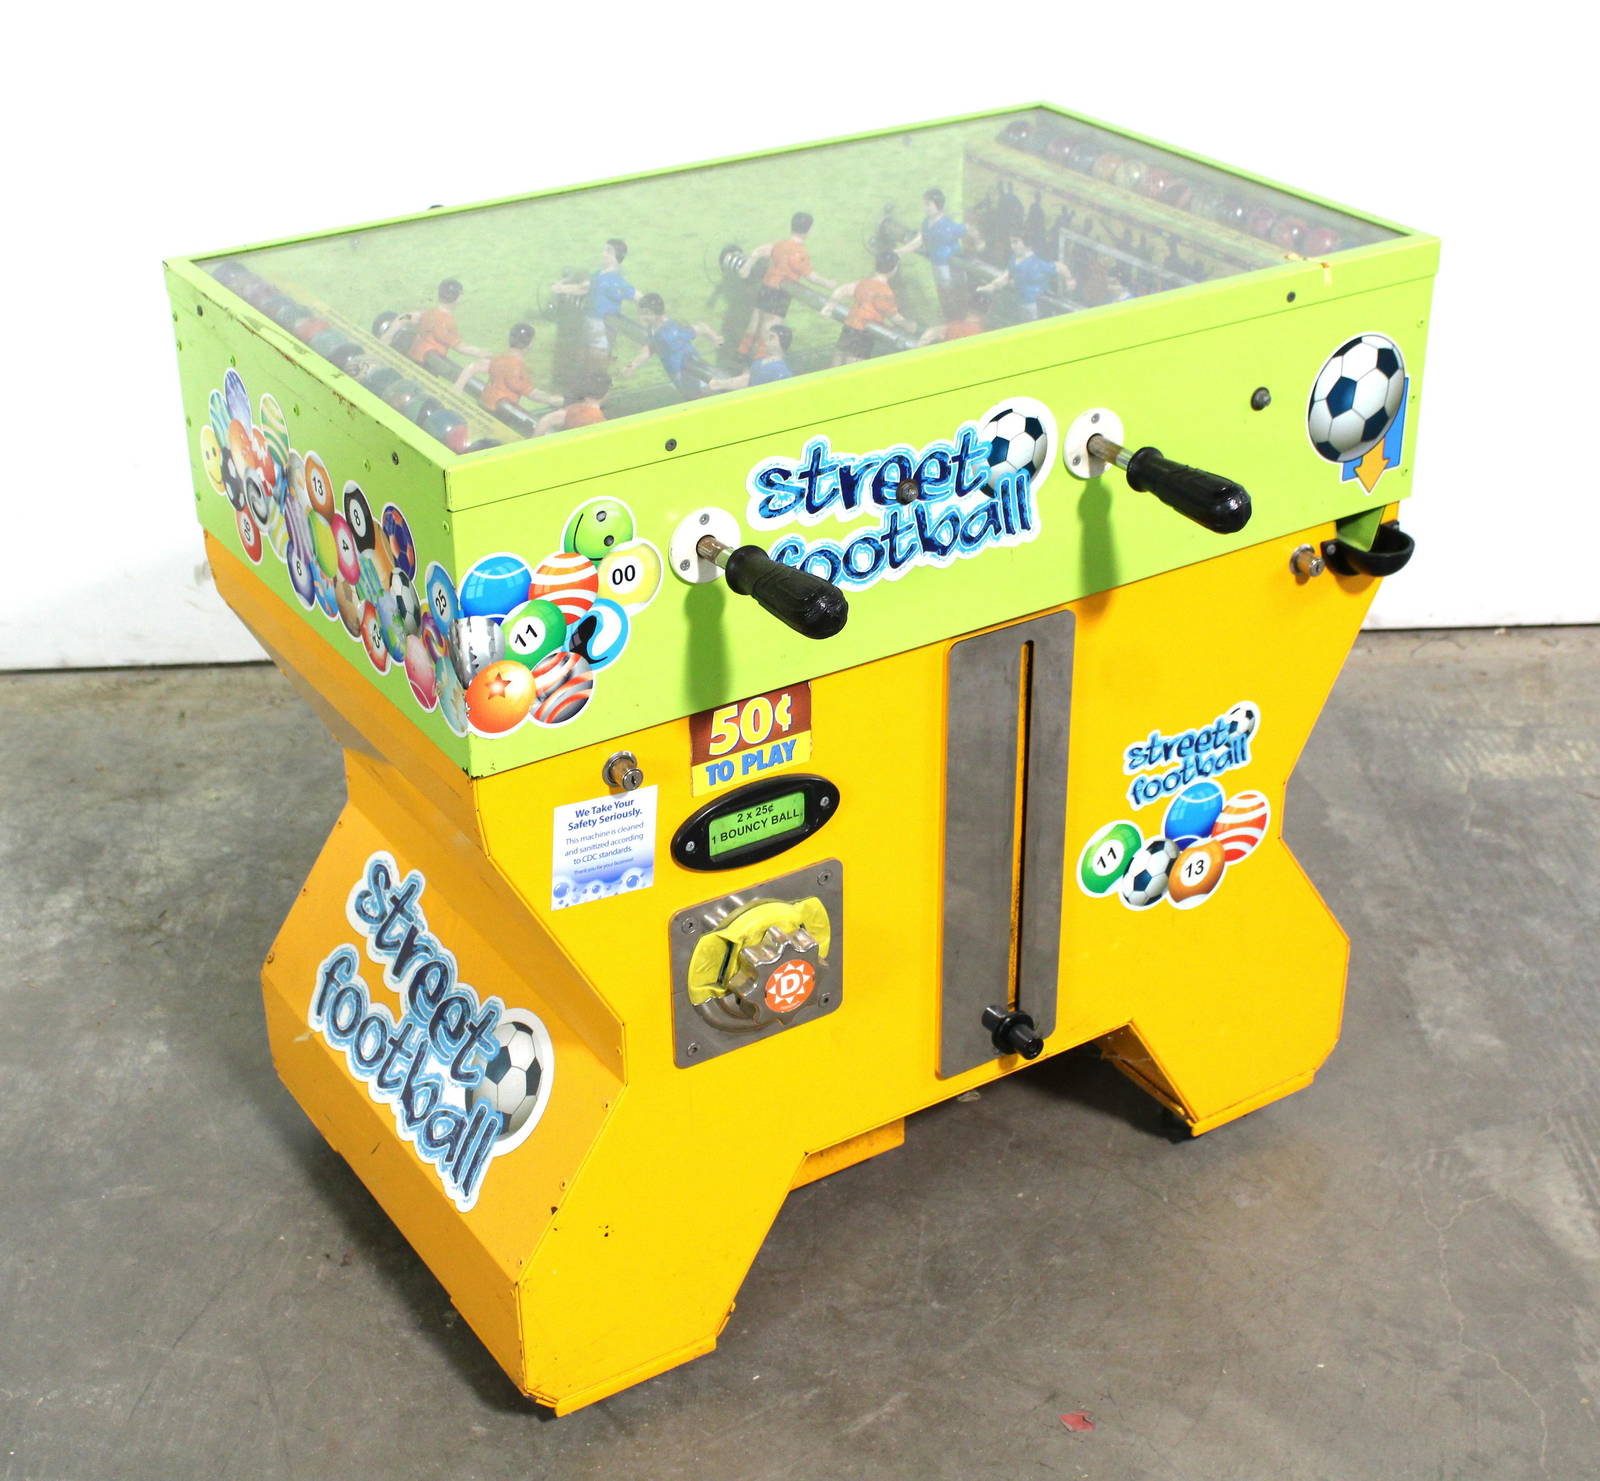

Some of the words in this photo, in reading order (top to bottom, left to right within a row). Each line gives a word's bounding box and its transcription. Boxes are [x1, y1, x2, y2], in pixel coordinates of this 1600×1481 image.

[755, 427, 992, 520] street
[313, 476, 324, 496] 13
[353, 509, 361, 526] 8
[342, 539, 349, 552] 4
[611, 564, 636, 586] 00
[435, 589, 447, 617] 25
[514, 624, 538, 648] 11
[708, 693, 792, 756] 50¢
[1128, 719, 1226, 770] street
[705, 760, 735, 786] TO
[741, 739, 797, 776] PLAY
[1131, 736, 1247, 805] football
[568, 818, 598, 831] Safety
[599, 807, 643, 824] Seriously.
[575, 809, 590, 819] We
[591, 804, 613, 815] Take
[614, 799, 635, 809] Your
[737, 813, 743, 823] 2
[755, 803, 774, 817] 25¢
[565, 837, 579, 846] This
[580, 830, 611, 843] machine
[617, 821, 645, 834] cleaned
[711, 835, 717, 845] 1
[720, 818, 768, 842] BOUNCY
[771, 808, 800, 825] BALL
[564, 847, 579, 857] and
[579, 840, 610, 854] sanitized
[610, 833, 644, 847] according
[582, 853, 598, 863] CDC
[598, 845, 632, 859] standards
[1097, 847, 1117, 869] 11
[1185, 859, 1205, 878] 13
[354, 861, 500, 1084] street
[780, 973, 801, 996] D
[314, 953, 501, 1197] football
